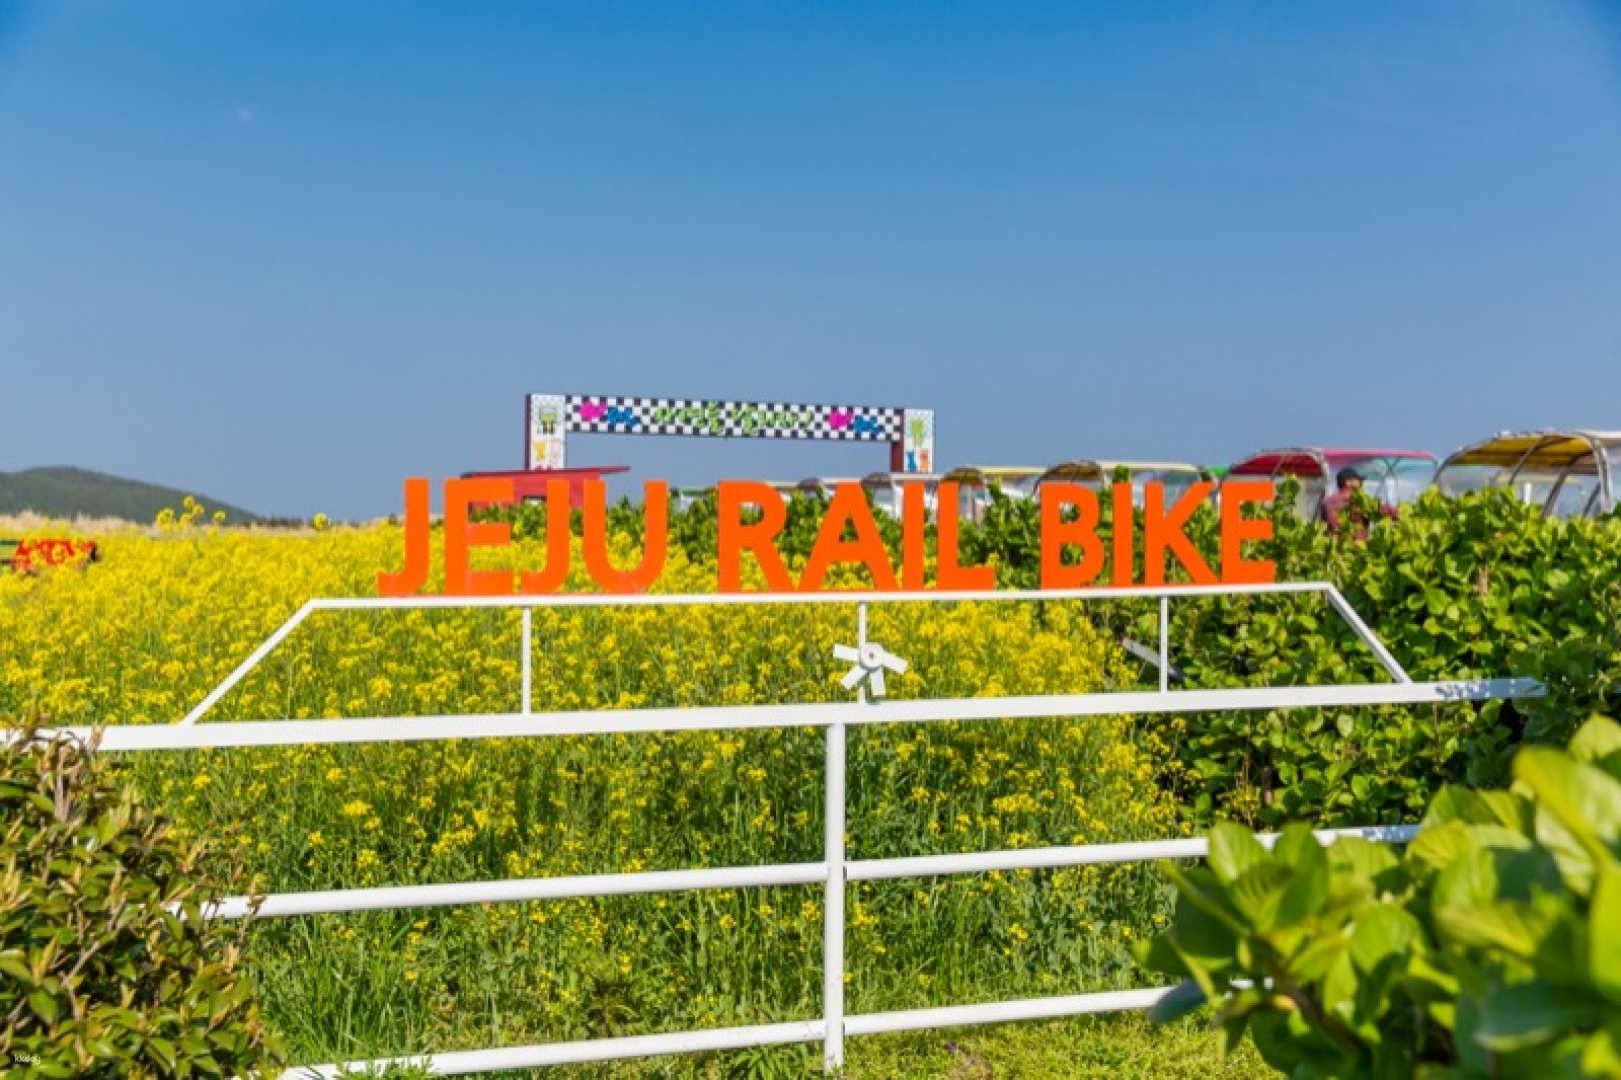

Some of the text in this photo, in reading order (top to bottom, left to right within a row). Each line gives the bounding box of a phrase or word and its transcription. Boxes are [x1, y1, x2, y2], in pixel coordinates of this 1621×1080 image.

[378, 477, 1277, 597] JEJU RAIL BIKE
